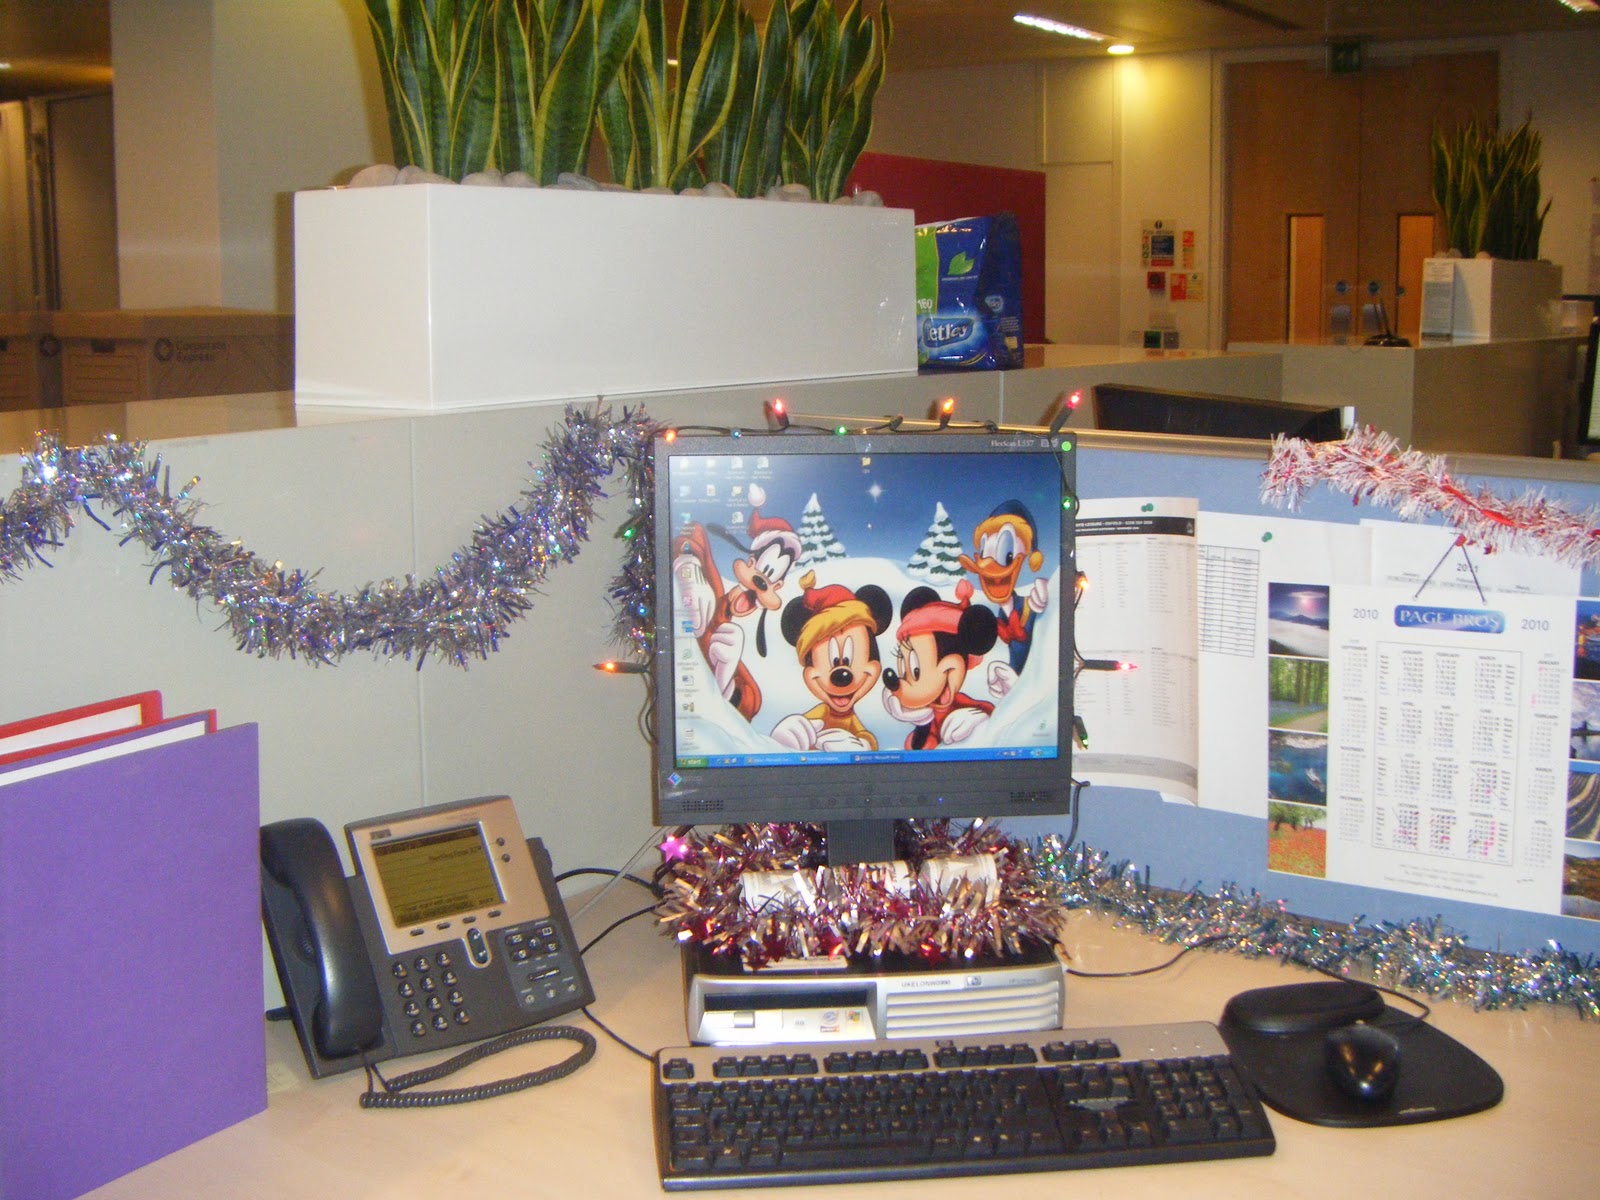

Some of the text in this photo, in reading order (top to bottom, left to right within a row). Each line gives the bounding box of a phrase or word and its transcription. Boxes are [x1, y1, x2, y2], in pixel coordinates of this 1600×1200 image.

[917, 298, 933, 310] 160
[927, 324, 968, 341] etley
[1353, 608, 1379, 620] 2010
[1400, 610, 1499, 629] PAGE BROS
[1521, 618, 1550, 631] 2010
